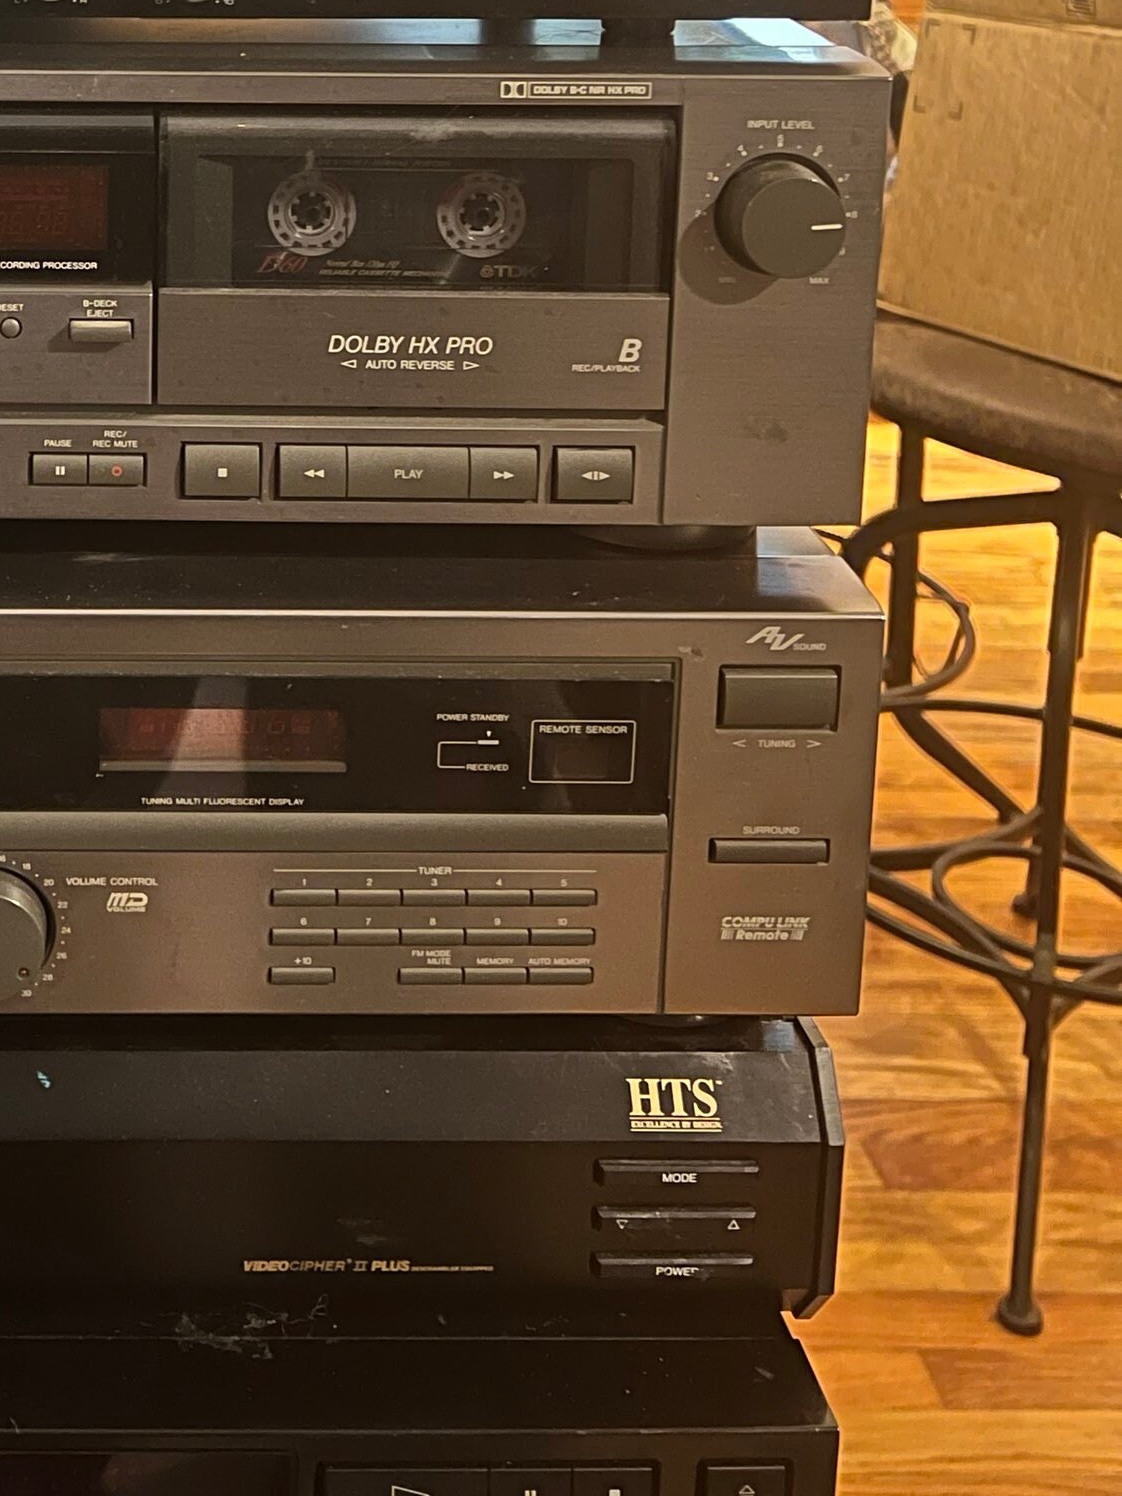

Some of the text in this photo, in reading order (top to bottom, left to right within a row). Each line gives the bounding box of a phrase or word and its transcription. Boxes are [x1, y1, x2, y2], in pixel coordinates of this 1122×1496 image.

[42, 260, 99, 271] PROCESSOR
[328, 335, 493, 356] DOLBY HX PRO
[619, 339, 642, 362] B
[364, 358, 455, 371] AUTO REVERSE
[393, 468, 425, 481] PLAY
[538, 724, 628, 735] REMOTE SENSOR
[65, 877, 158, 887] VOLUME CONTROL
[626, 1078, 718, 1117] HTS
[661, 1173, 698, 1184] MODE
